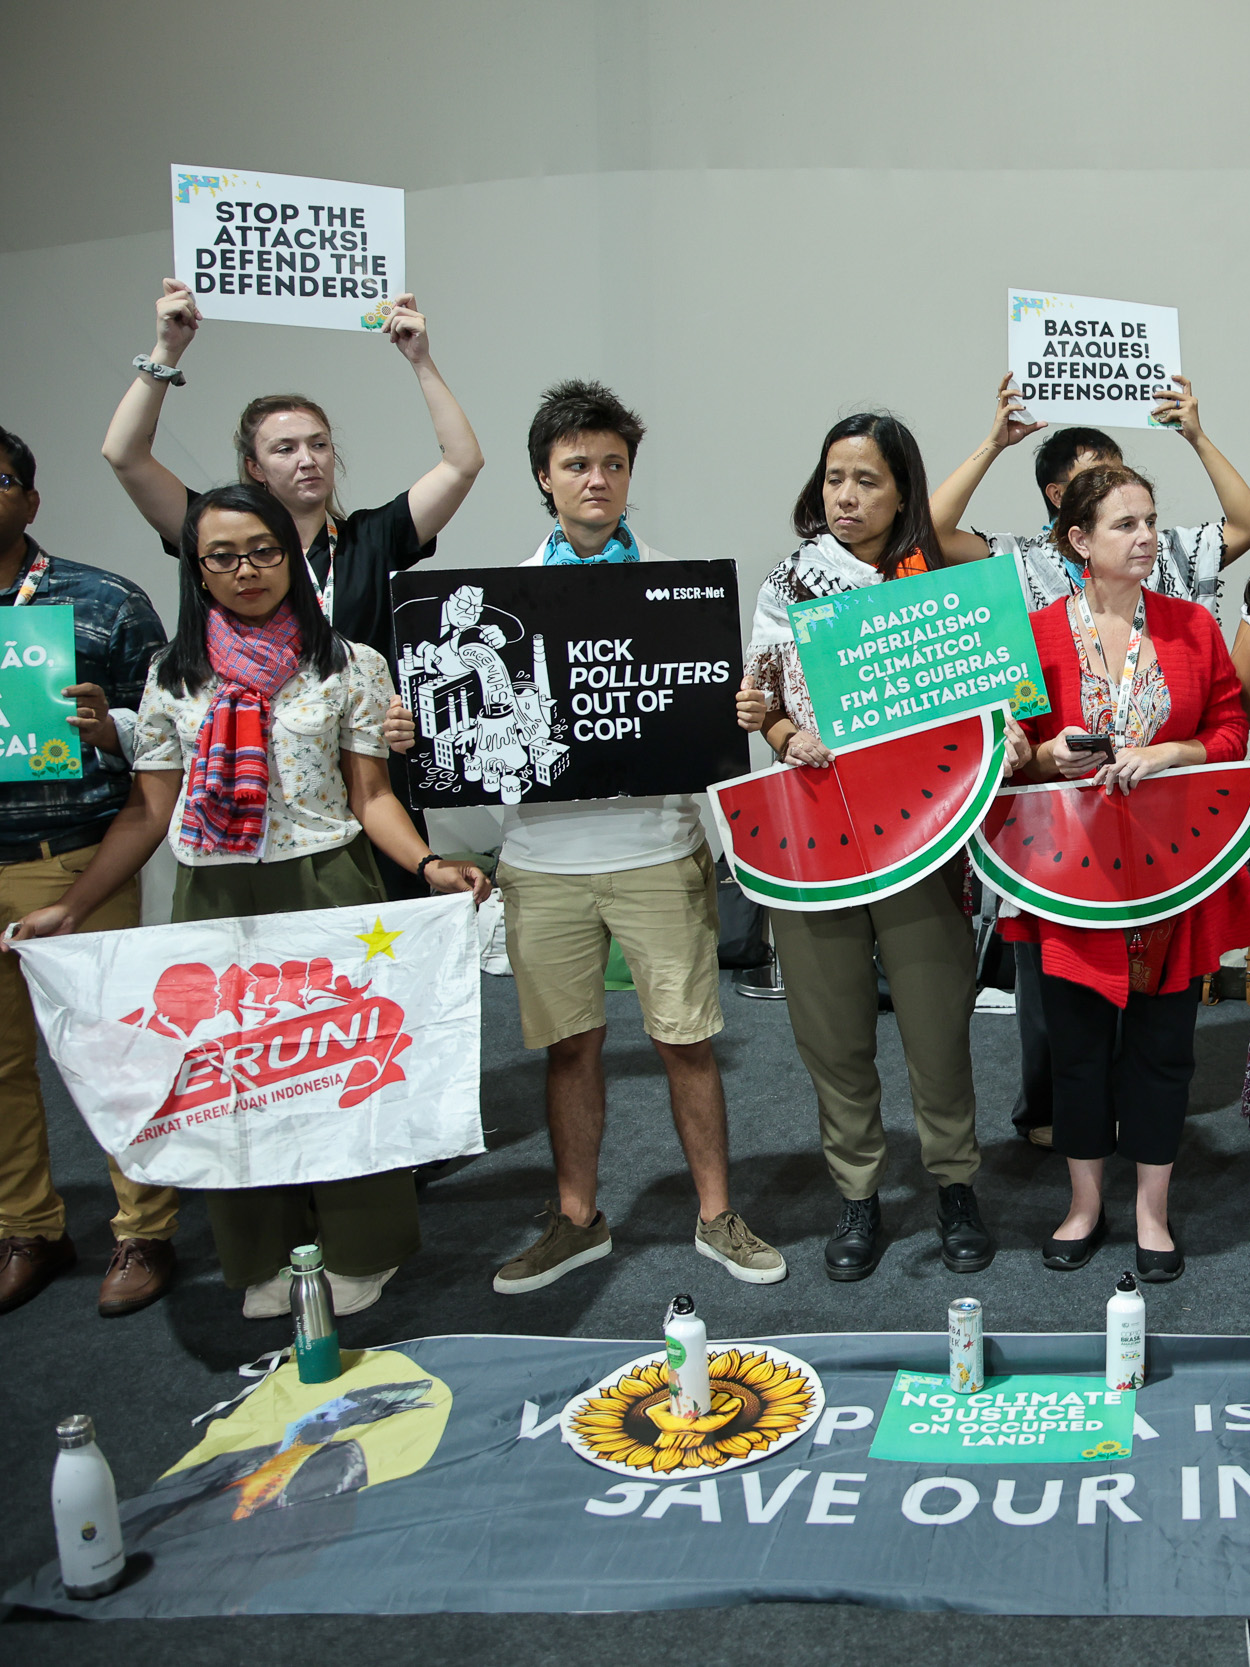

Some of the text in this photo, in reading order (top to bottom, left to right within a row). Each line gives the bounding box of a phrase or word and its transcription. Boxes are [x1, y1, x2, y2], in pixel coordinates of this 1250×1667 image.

[216, 201, 365, 228] STOP THE
[214, 225, 367, 252] ATTACKS!
[196, 248, 386, 275] DEFEND THE
[195, 272, 388, 298] DEFENDERS!
[1045, 319, 1147, 339] BASTA DE
[1043, 340, 1150, 359] ATAQUES!
[1028, 362, 1166, 380] DEFENDA OS
[673, 586, 725, 600] ESCR-Net
[860, 593, 960, 638] ABAIXO O
[837, 606, 991, 667] IMPERIALISMO
[567, 638, 634, 663] KICK
[858, 632, 982, 682] CLIMÁTICO!
[569, 661, 730, 690] POLLUTERS
[840, 646, 1011, 712] FIM ÀS GUERRAS
[571, 689, 674, 716] OUT OF
[832, 663, 1029, 737] E AO MILITARISMO!
[573, 717, 642, 742] COP!
[271, 1072, 344, 1104] INDONESIA
[901, 1391, 1122, 1407] NO CLIMATE
[908, 1420, 1104, 1434] ON OCCUPIED
[931, 1405, 1086, 1422] JUSTICE
[962, 1433, 1045, 1447] LAND!
[584, 1470, 868, 1525] SAVE
[901, 1472, 1143, 1526] OUR
